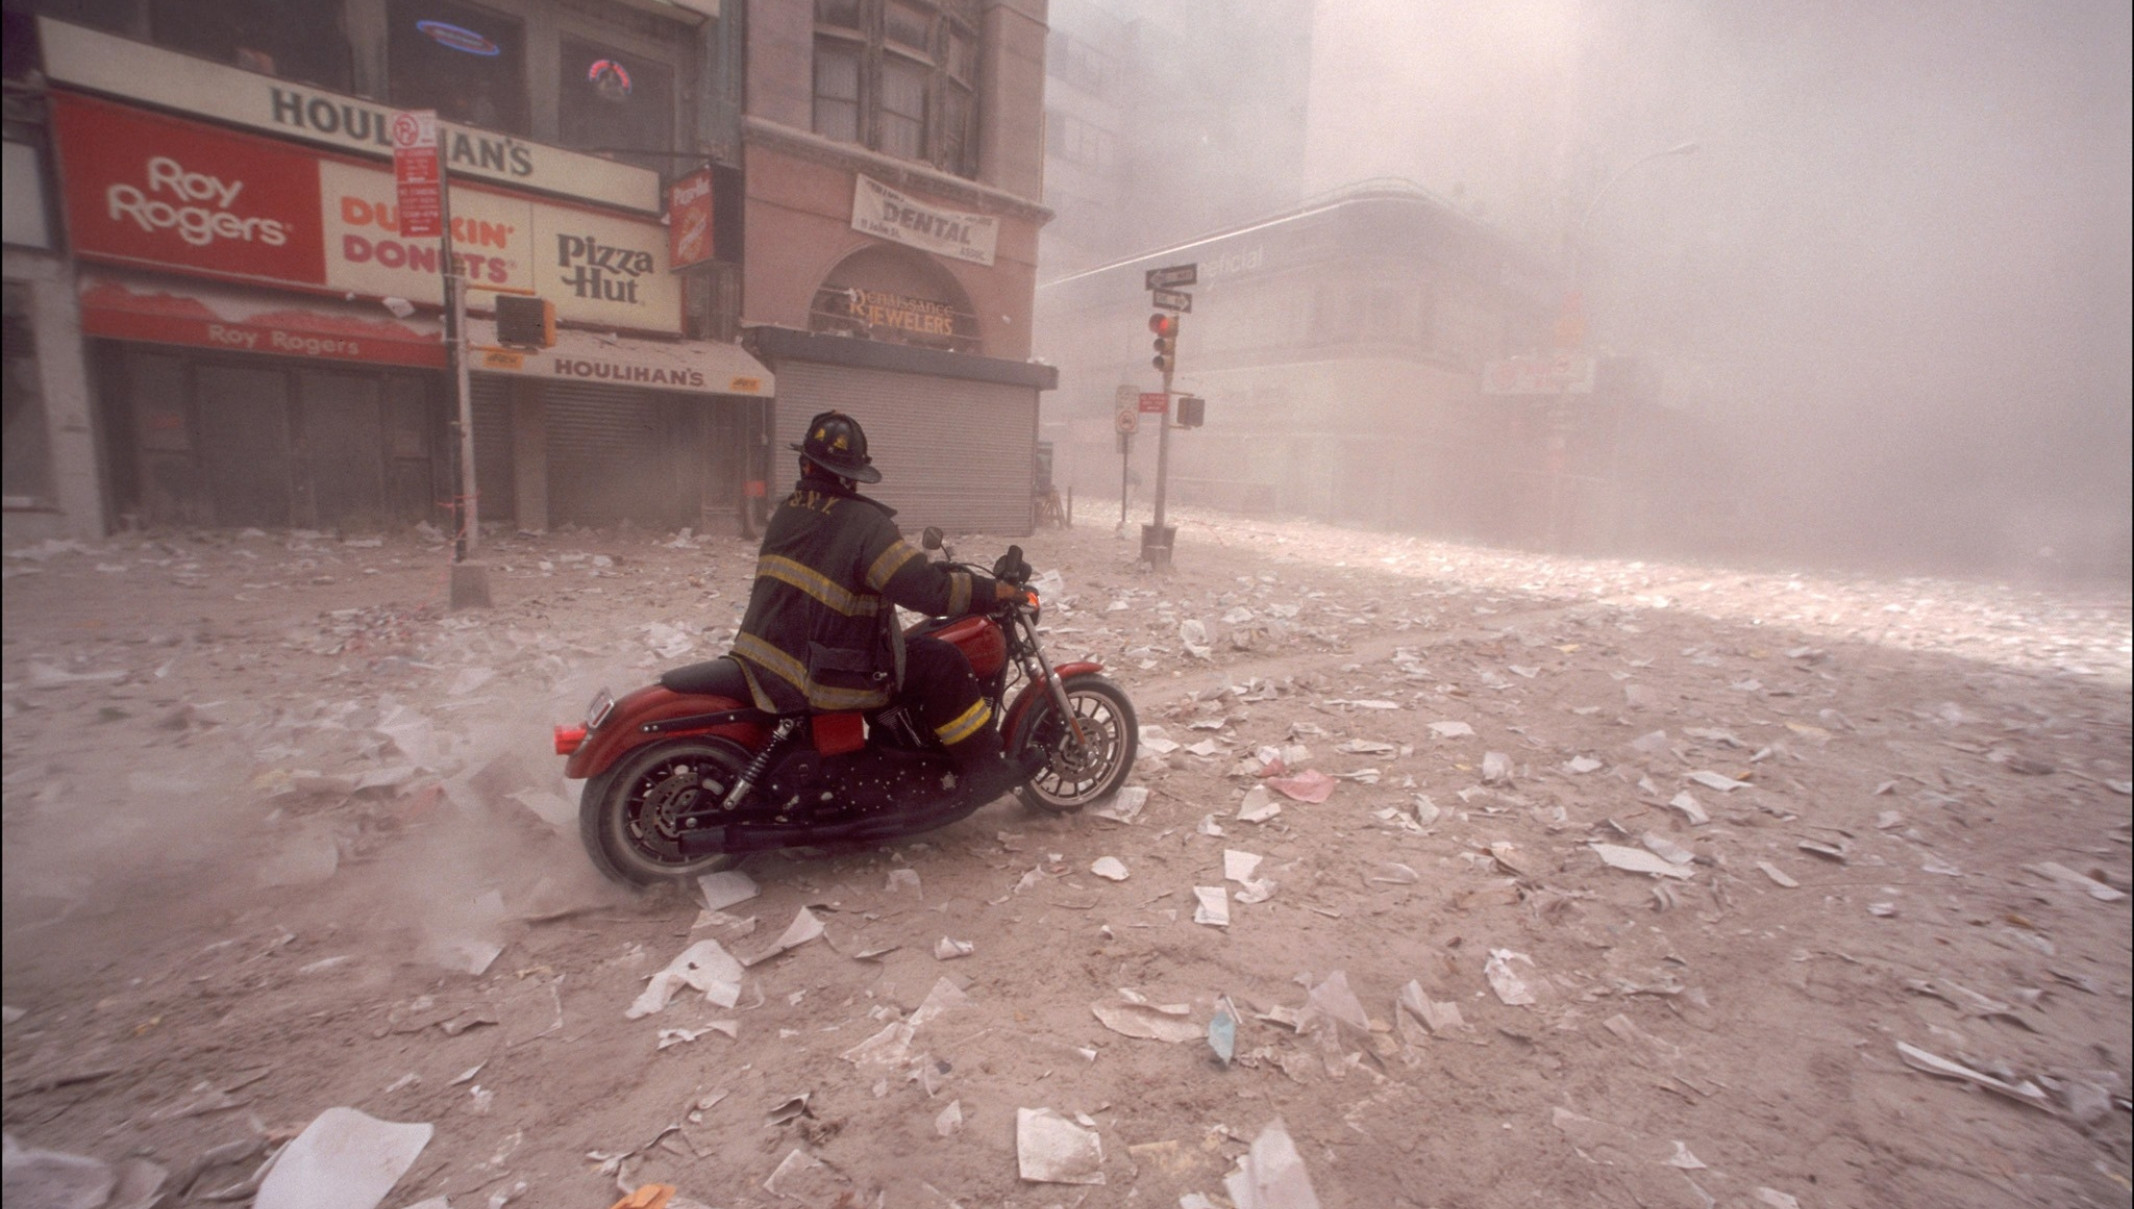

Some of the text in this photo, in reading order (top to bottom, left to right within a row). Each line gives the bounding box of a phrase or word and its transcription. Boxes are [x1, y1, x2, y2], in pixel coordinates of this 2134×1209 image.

[269, 87, 533, 176] HOULAN'S
[149, 156, 242, 208] Roy
[106, 184, 287, 245] Rogers
[341, 196, 514, 250] DUKIN'
[883, 200, 970, 246] DENTAL
[557, 233, 654, 276] Pizza
[561, 265, 639, 305] Hut
[209, 324, 359, 355] Roy Rogers
[868, 304, 953, 336] JEWELERS
[555, 358, 704, 387] HOULIHAN'S
